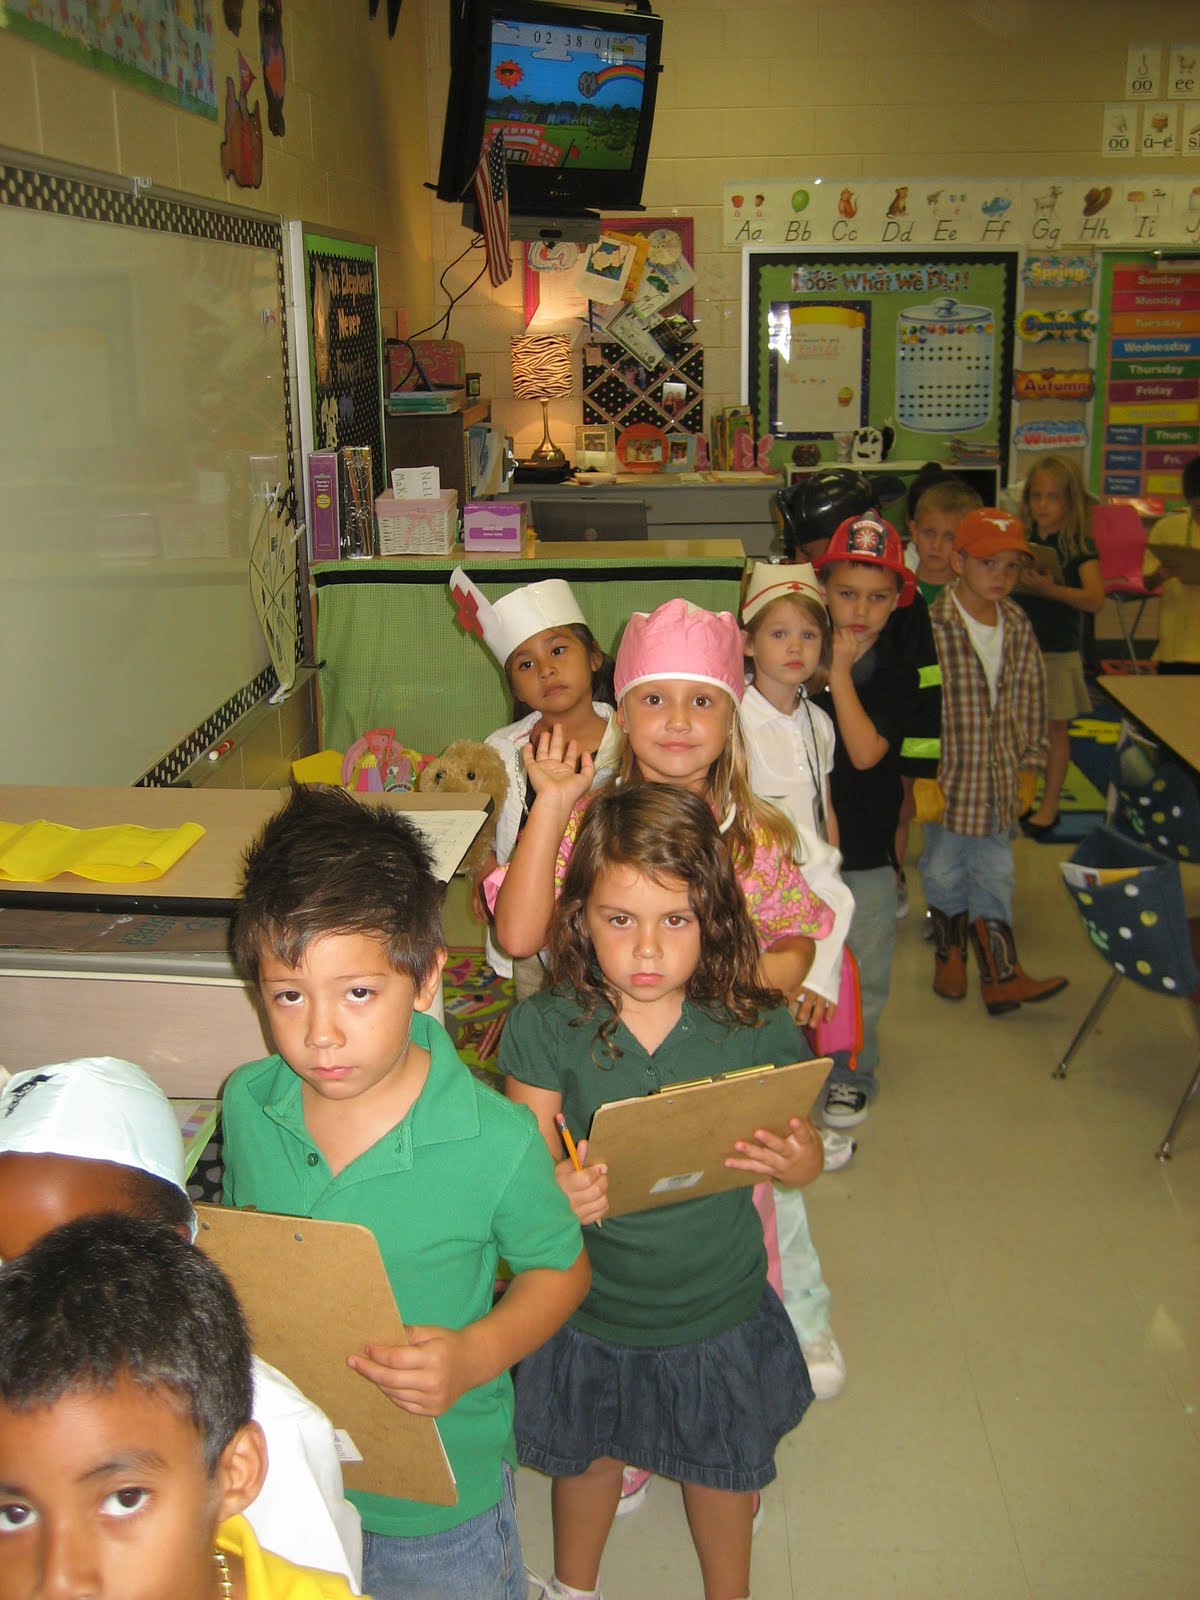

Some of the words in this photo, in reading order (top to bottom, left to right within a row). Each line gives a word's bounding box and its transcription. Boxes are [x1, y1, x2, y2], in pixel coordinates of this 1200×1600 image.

[1175, 79, 1194, 91] ee
[735, 220, 763, 240] Aa
[785, 220, 812, 242] Bb
[832, 220, 858, 241] Cc
[882, 220, 914, 242] Dd
[934, 219, 958, 241] Ee
[981, 220, 1010, 241] Ff
[1032, 218, 1061, 250] Gg
[1080, 218, 1110, 240] Hh
[1135, 216, 1155, 238] Ii
[1030, 261, 1086, 282] Spring
[793, 271, 838, 291] Look
[841, 270, 892, 291] What
[895, 271, 923, 291] We
[1137, 275, 1182, 286] Sunday
[1135, 296, 1181, 306] Monday
[337, 308, 361, 340] Never
[1123, 343, 1192, 353] Wednesday
[1128, 364, 1185, 375] Thursday
[1024, 378, 1089, 392] Autumn
[1135, 385, 1174, 397] Friday
[1023, 431, 1082, 445] Winter
